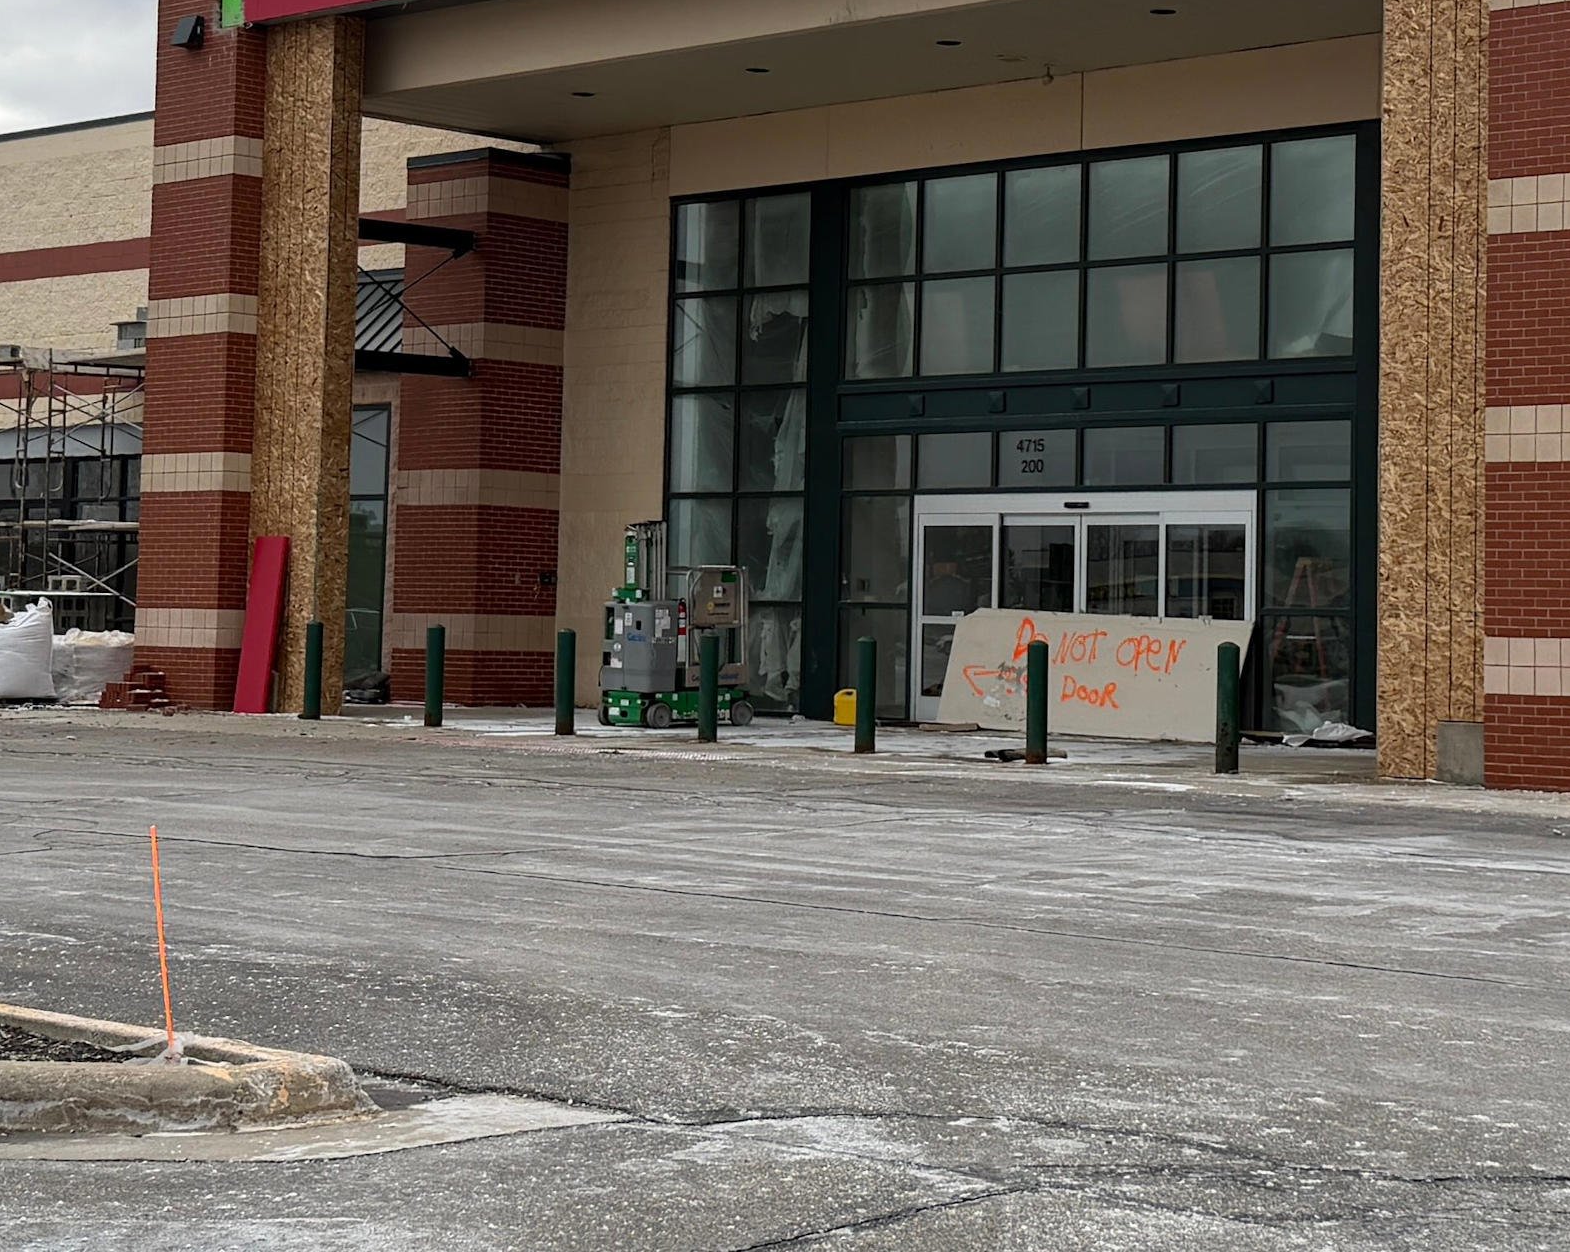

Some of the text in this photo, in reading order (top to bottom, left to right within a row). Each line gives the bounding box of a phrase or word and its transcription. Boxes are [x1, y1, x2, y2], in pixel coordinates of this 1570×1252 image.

[1016, 438, 1045, 453] 4715
[1021, 459, 1044, 474] 200
[1052, 628, 1108, 665] NOT
